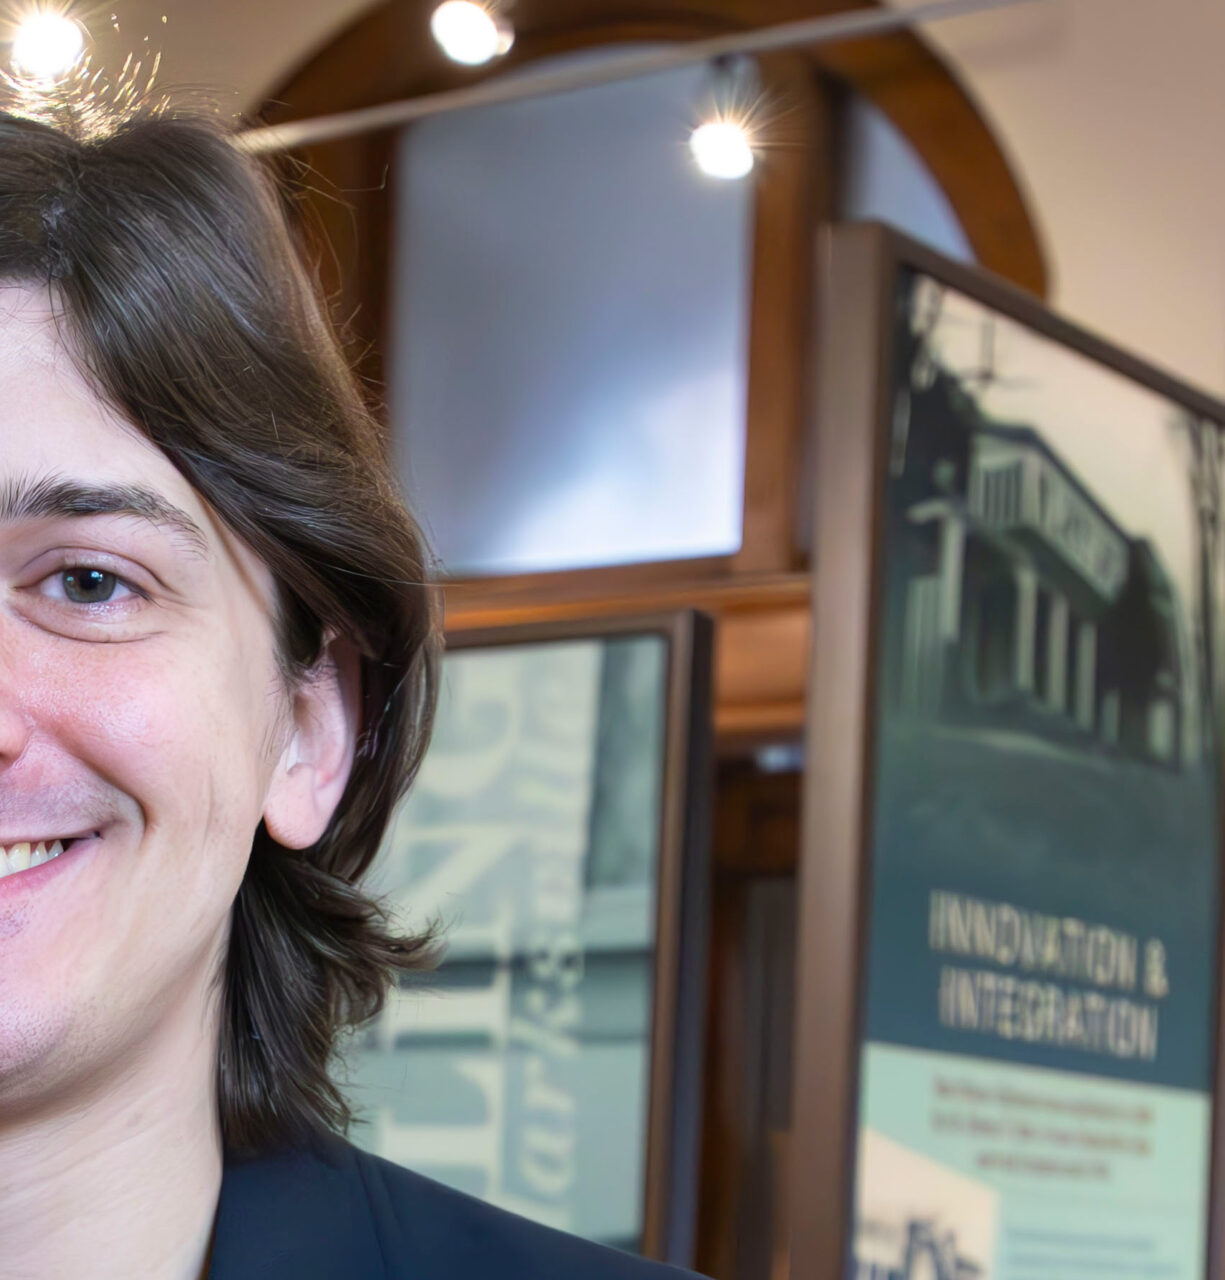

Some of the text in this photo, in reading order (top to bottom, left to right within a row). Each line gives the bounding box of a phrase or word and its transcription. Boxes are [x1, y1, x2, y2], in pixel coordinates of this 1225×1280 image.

[928, 889, 1169, 998] INNOVATION &
[938, 963, 1158, 1062] INTEGRATION
